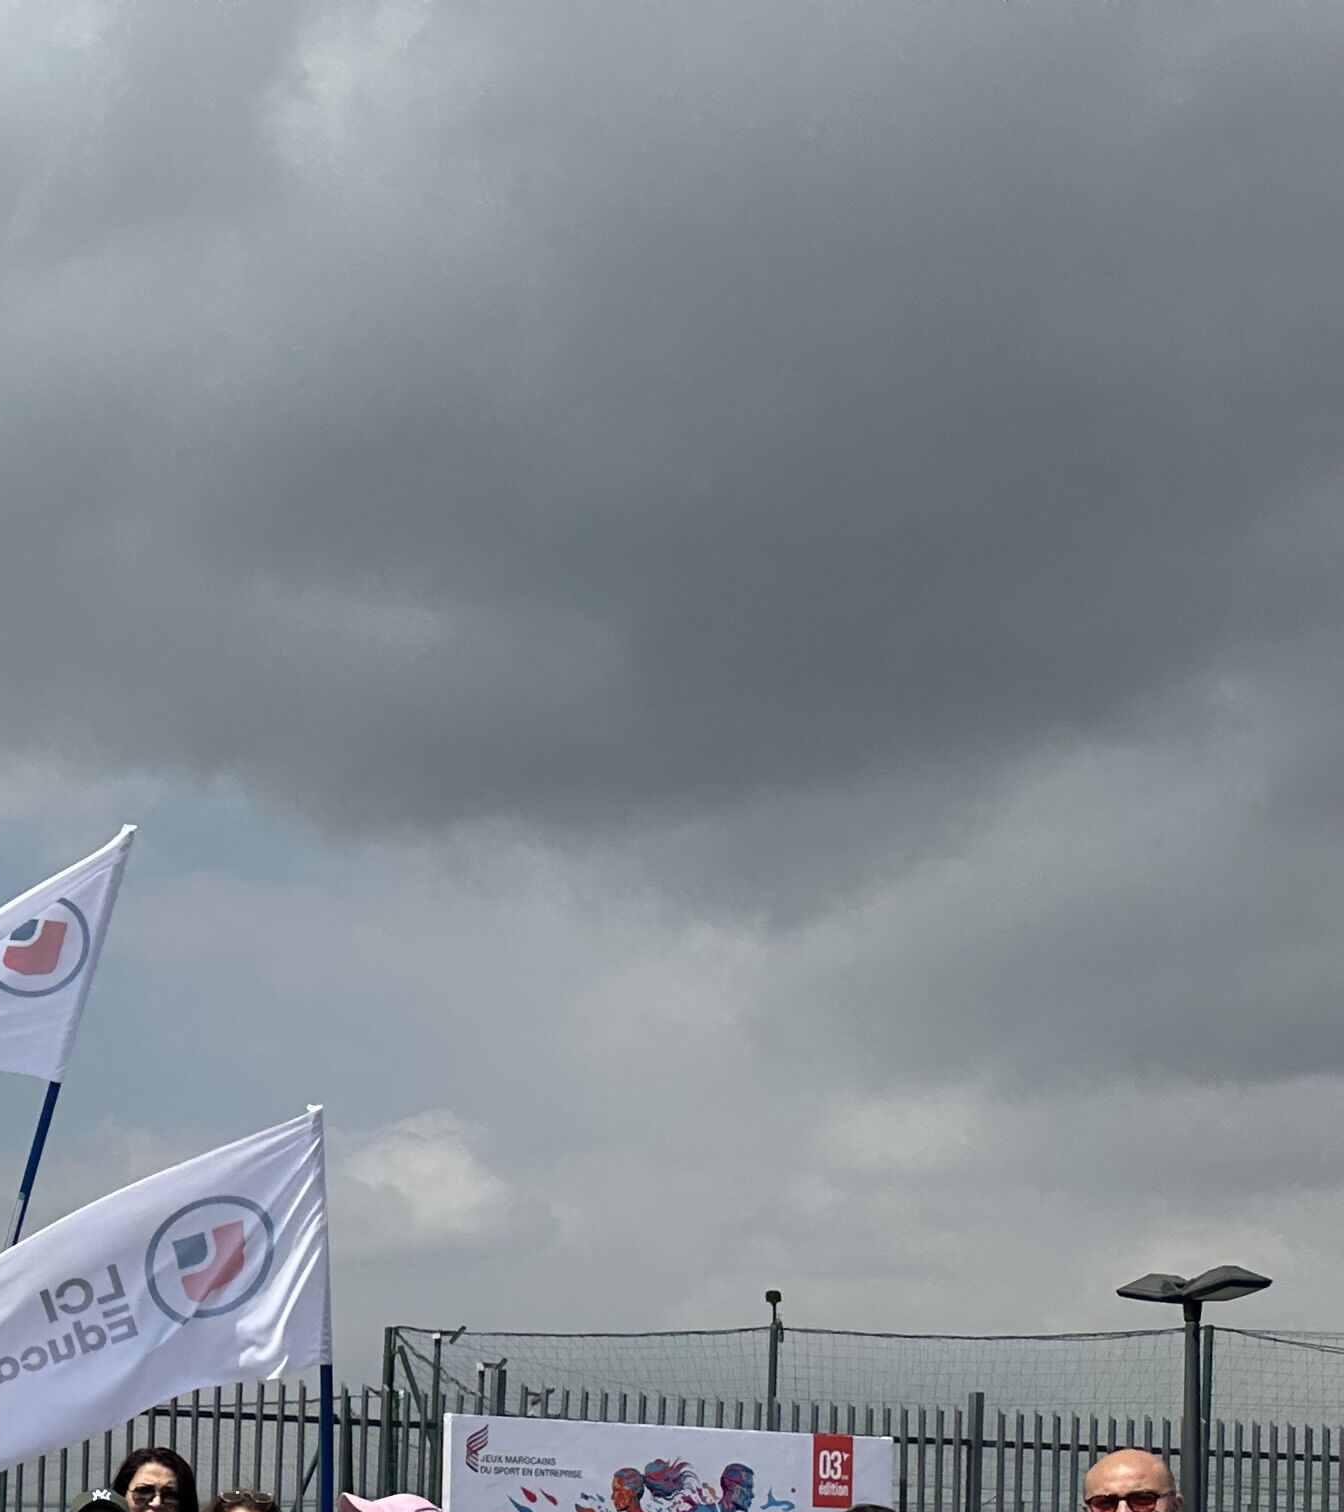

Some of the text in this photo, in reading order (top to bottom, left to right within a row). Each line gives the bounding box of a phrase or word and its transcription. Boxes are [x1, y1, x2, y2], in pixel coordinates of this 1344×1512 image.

[480, 1455, 557, 1466] JEUX MAROCAINS
[819, 1450, 842, 1480] 03
[480, 1466, 583, 1479] DU SPORT EN ENTREPRISE
